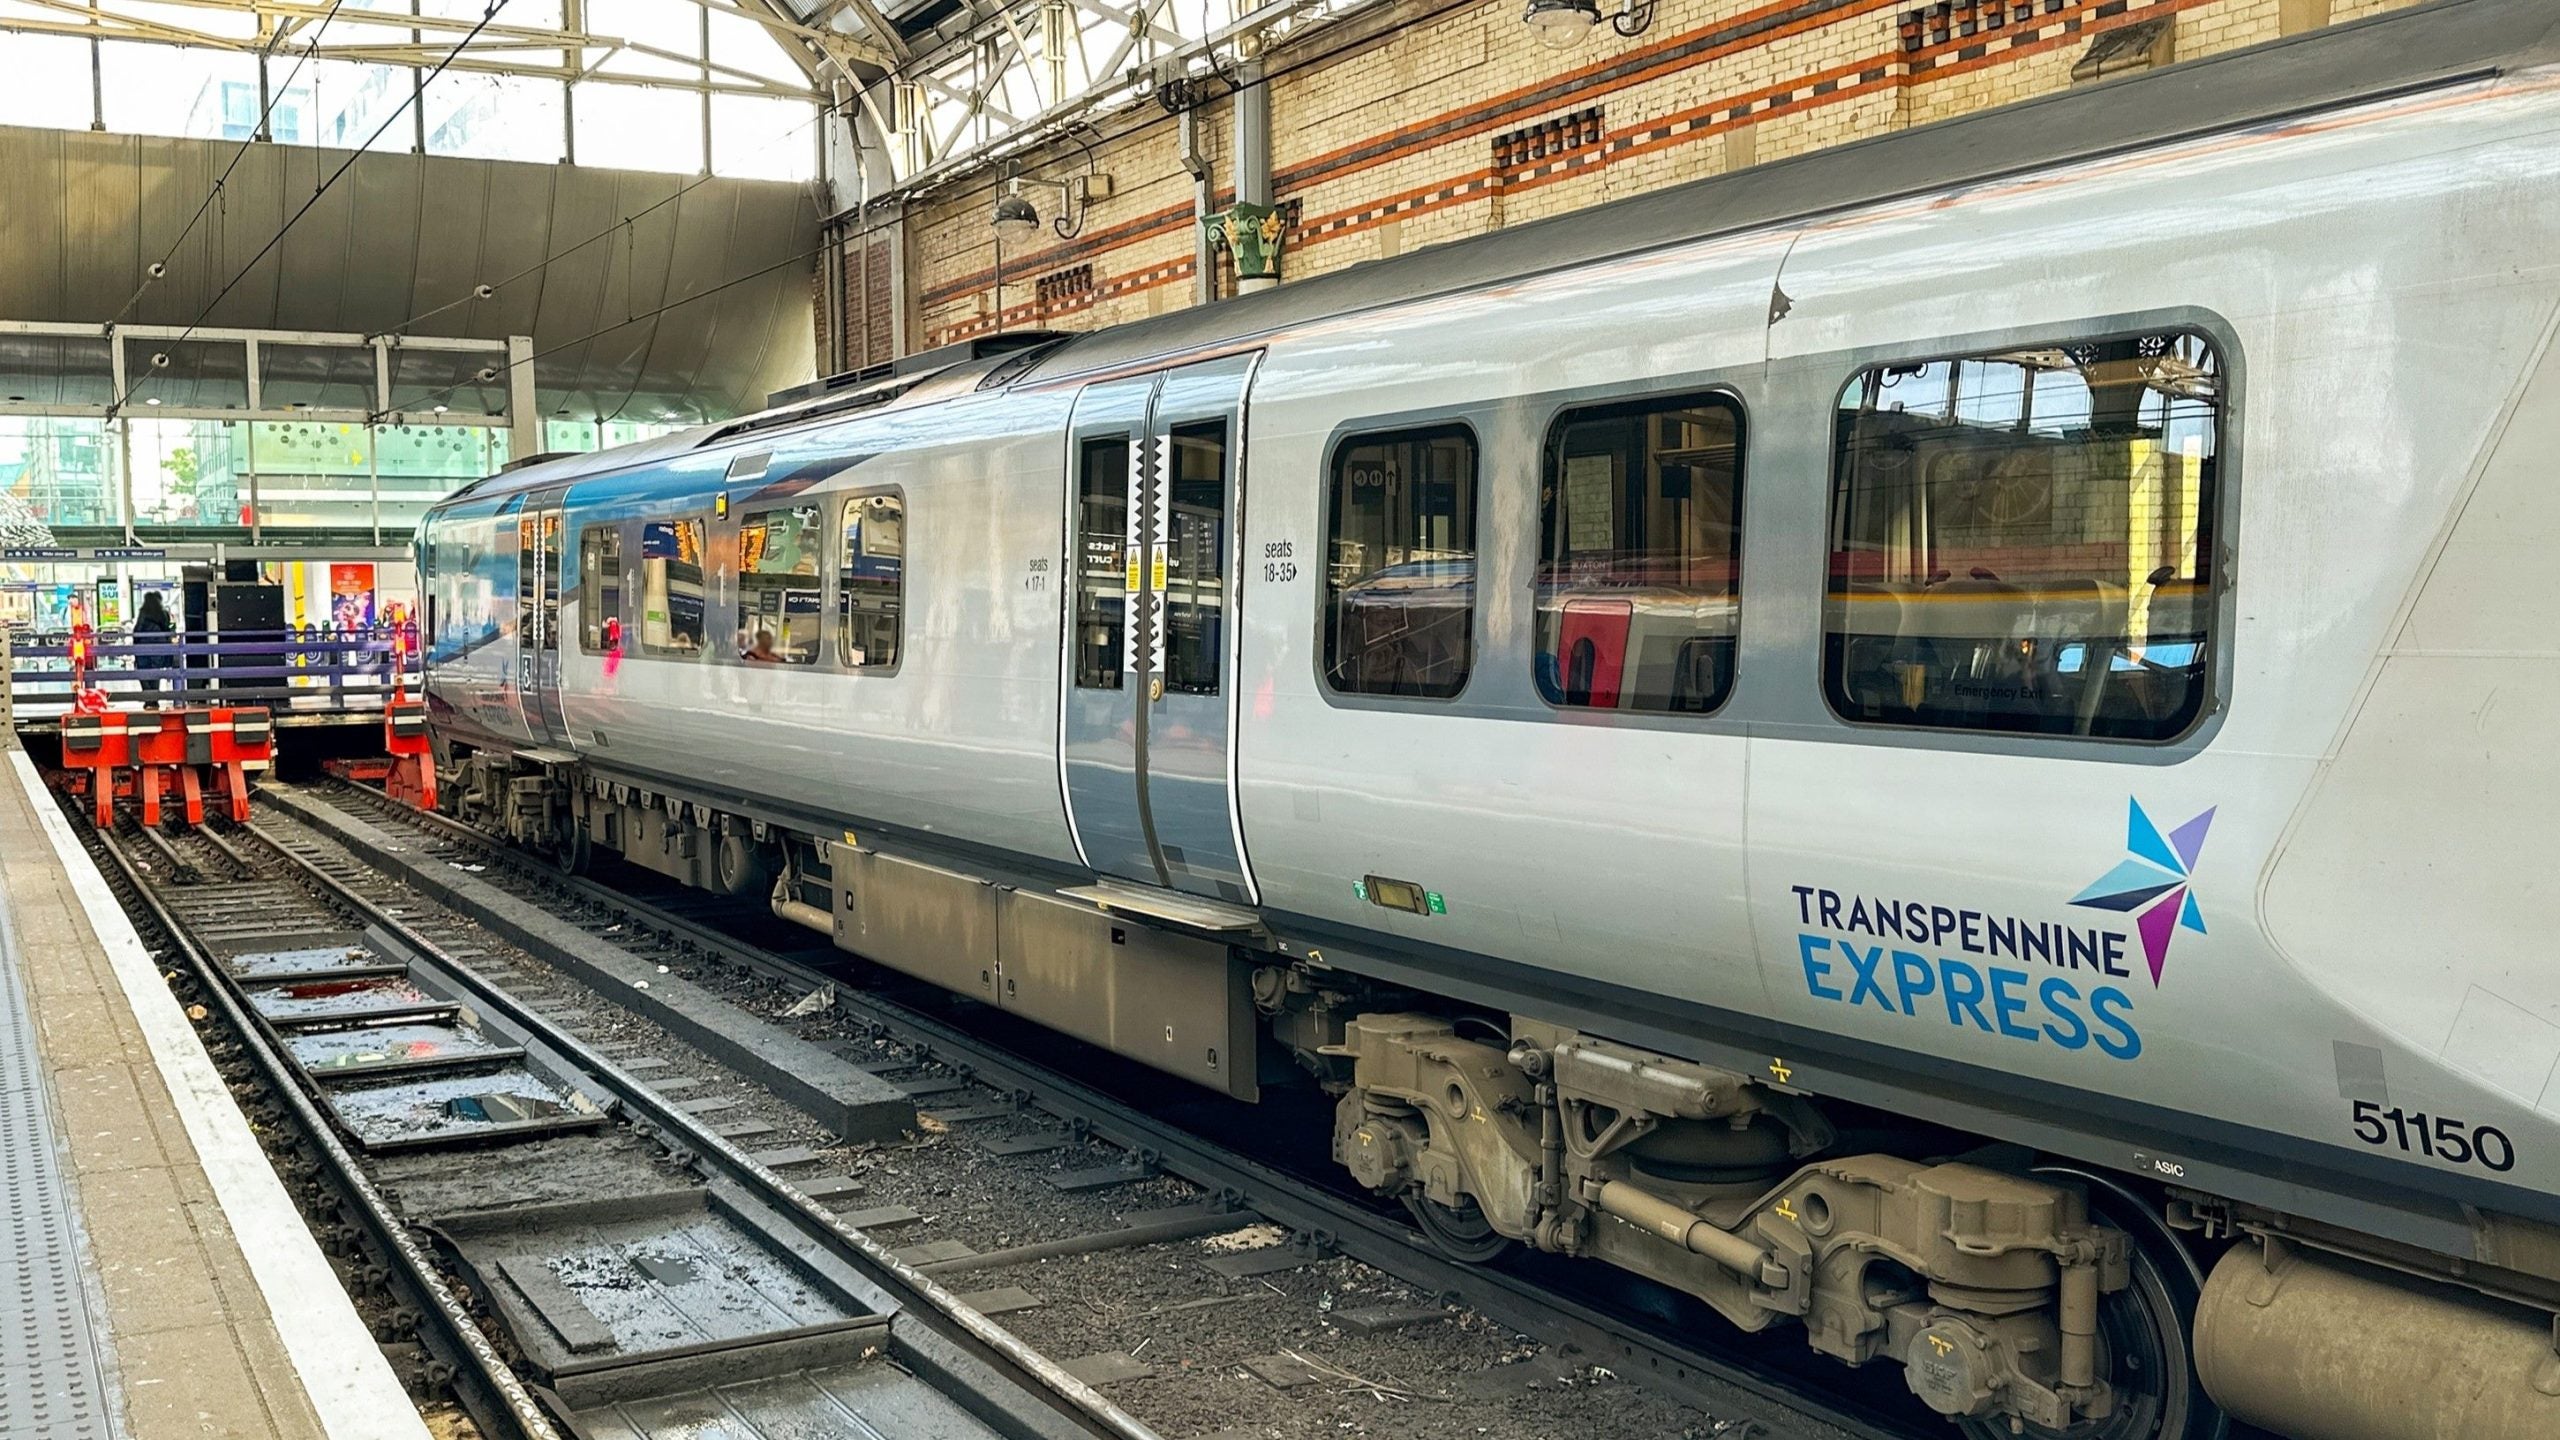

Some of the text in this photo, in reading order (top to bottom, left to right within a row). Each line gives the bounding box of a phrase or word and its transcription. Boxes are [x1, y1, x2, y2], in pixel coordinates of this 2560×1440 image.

[1265, 538, 1293, 558] seats
[1029, 556, 1048, 572] seats
[1264, 562, 1292, 582] 18-35
[1032, 576, 1045, 591] 17-1
[1954, 684, 2043, 700] Emergency Exit
[1792, 885, 2130, 978] TRANSPENNINE
[1797, 933, 2143, 1061] EXPRESS
[2352, 1099, 2516, 1172] 51150
[2154, 1159, 2185, 1178] ASIC
